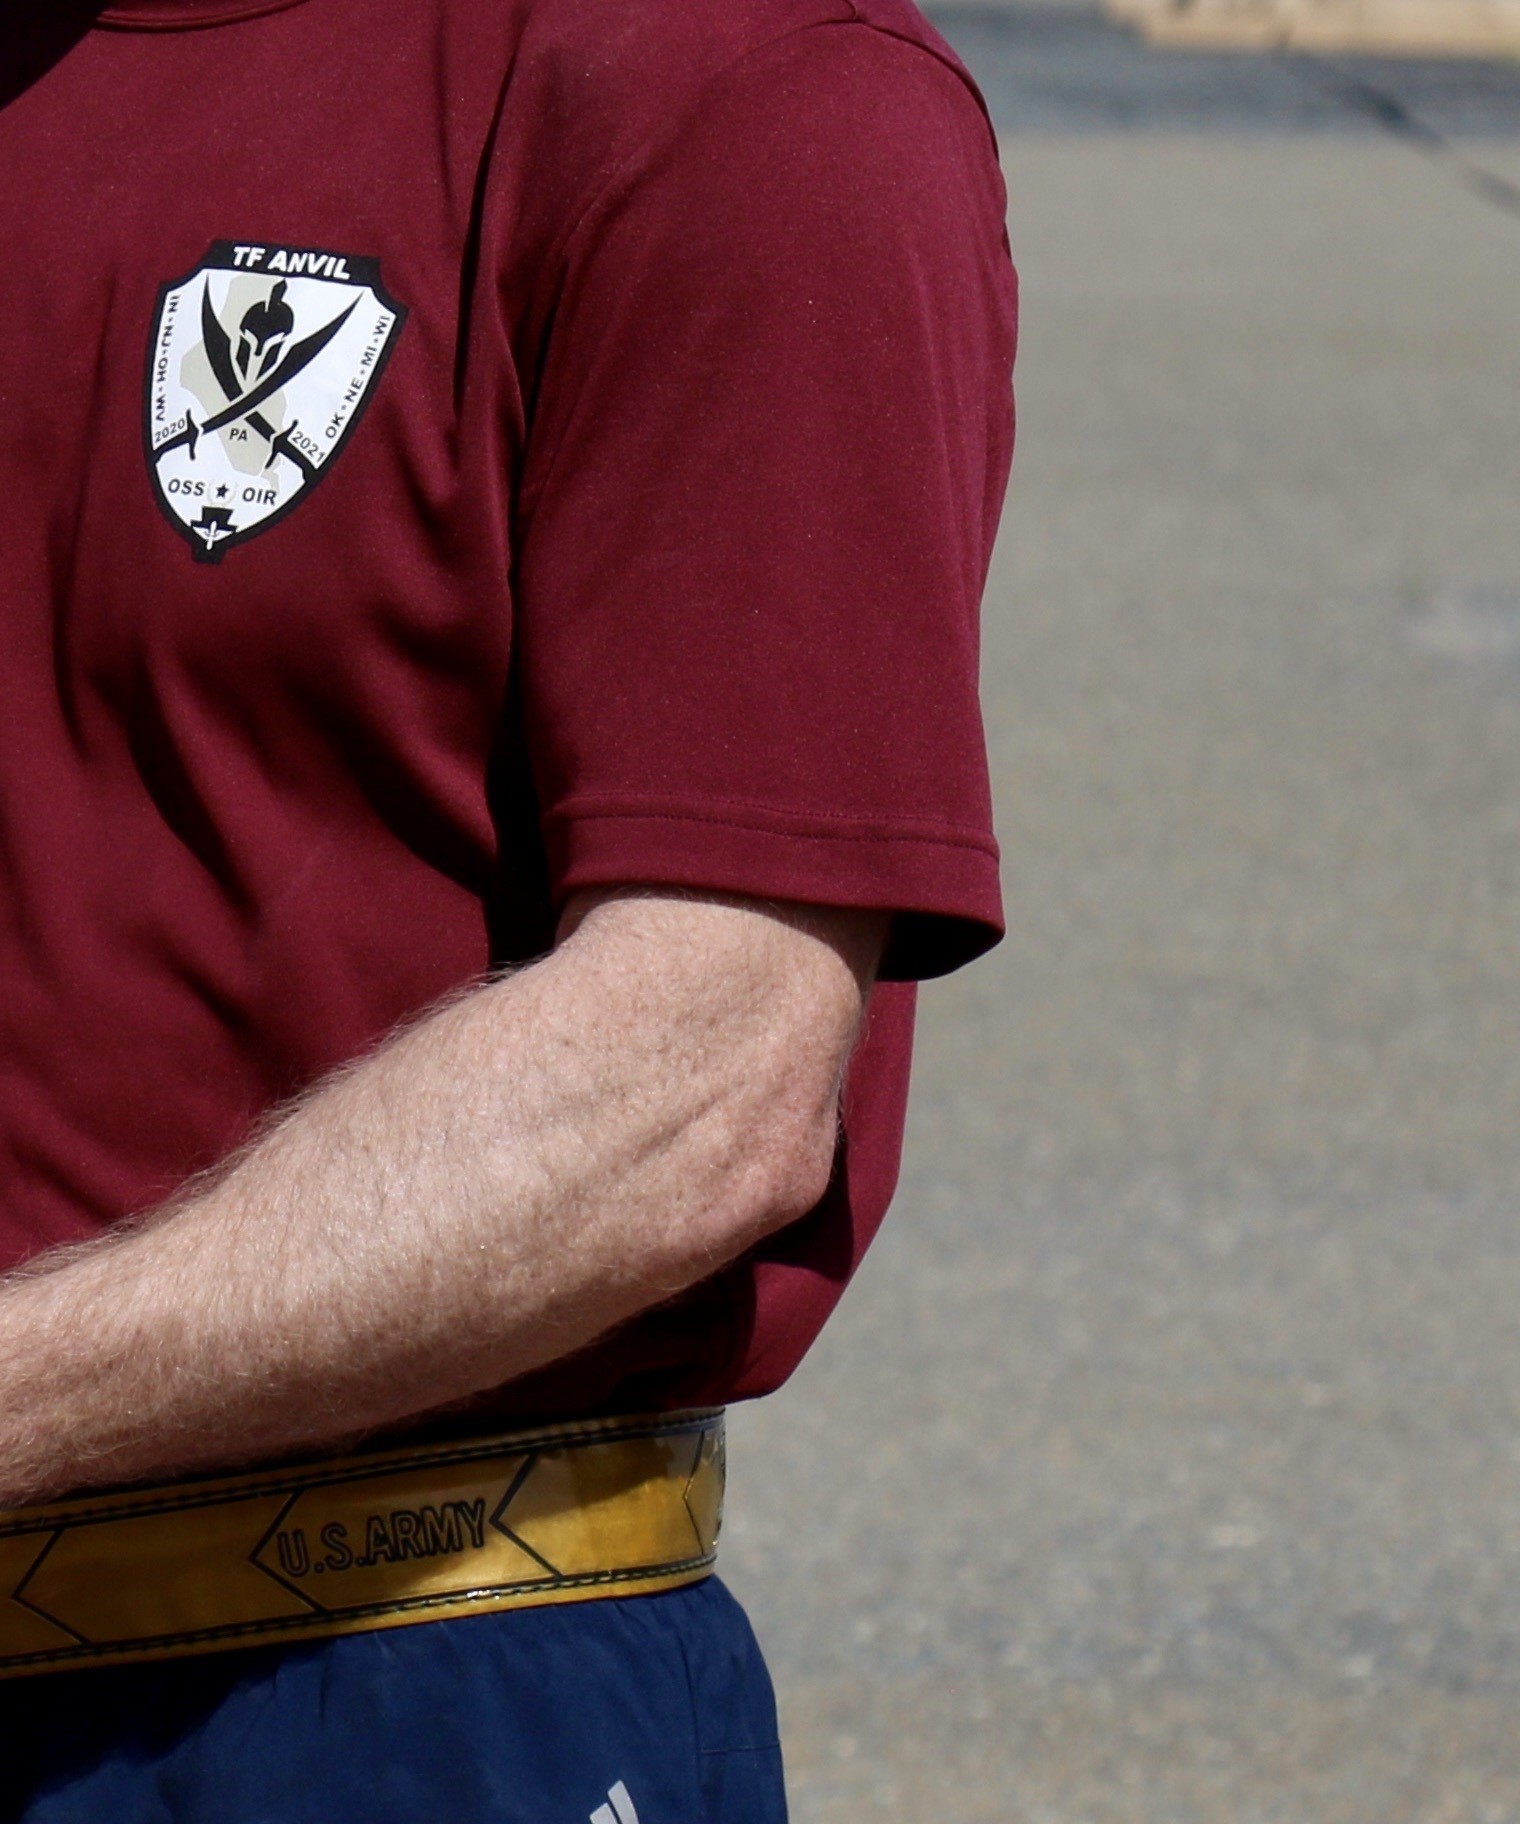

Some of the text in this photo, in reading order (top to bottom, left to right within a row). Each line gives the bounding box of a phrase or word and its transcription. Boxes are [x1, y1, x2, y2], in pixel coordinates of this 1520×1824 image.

[233, 246, 351, 278] TF ANVIL
[154, 417, 186, 443] 2020
[229, 427, 248, 441] PA
[292, 431, 326, 463] 2021
[168, 479, 277, 506] OSS OIR
